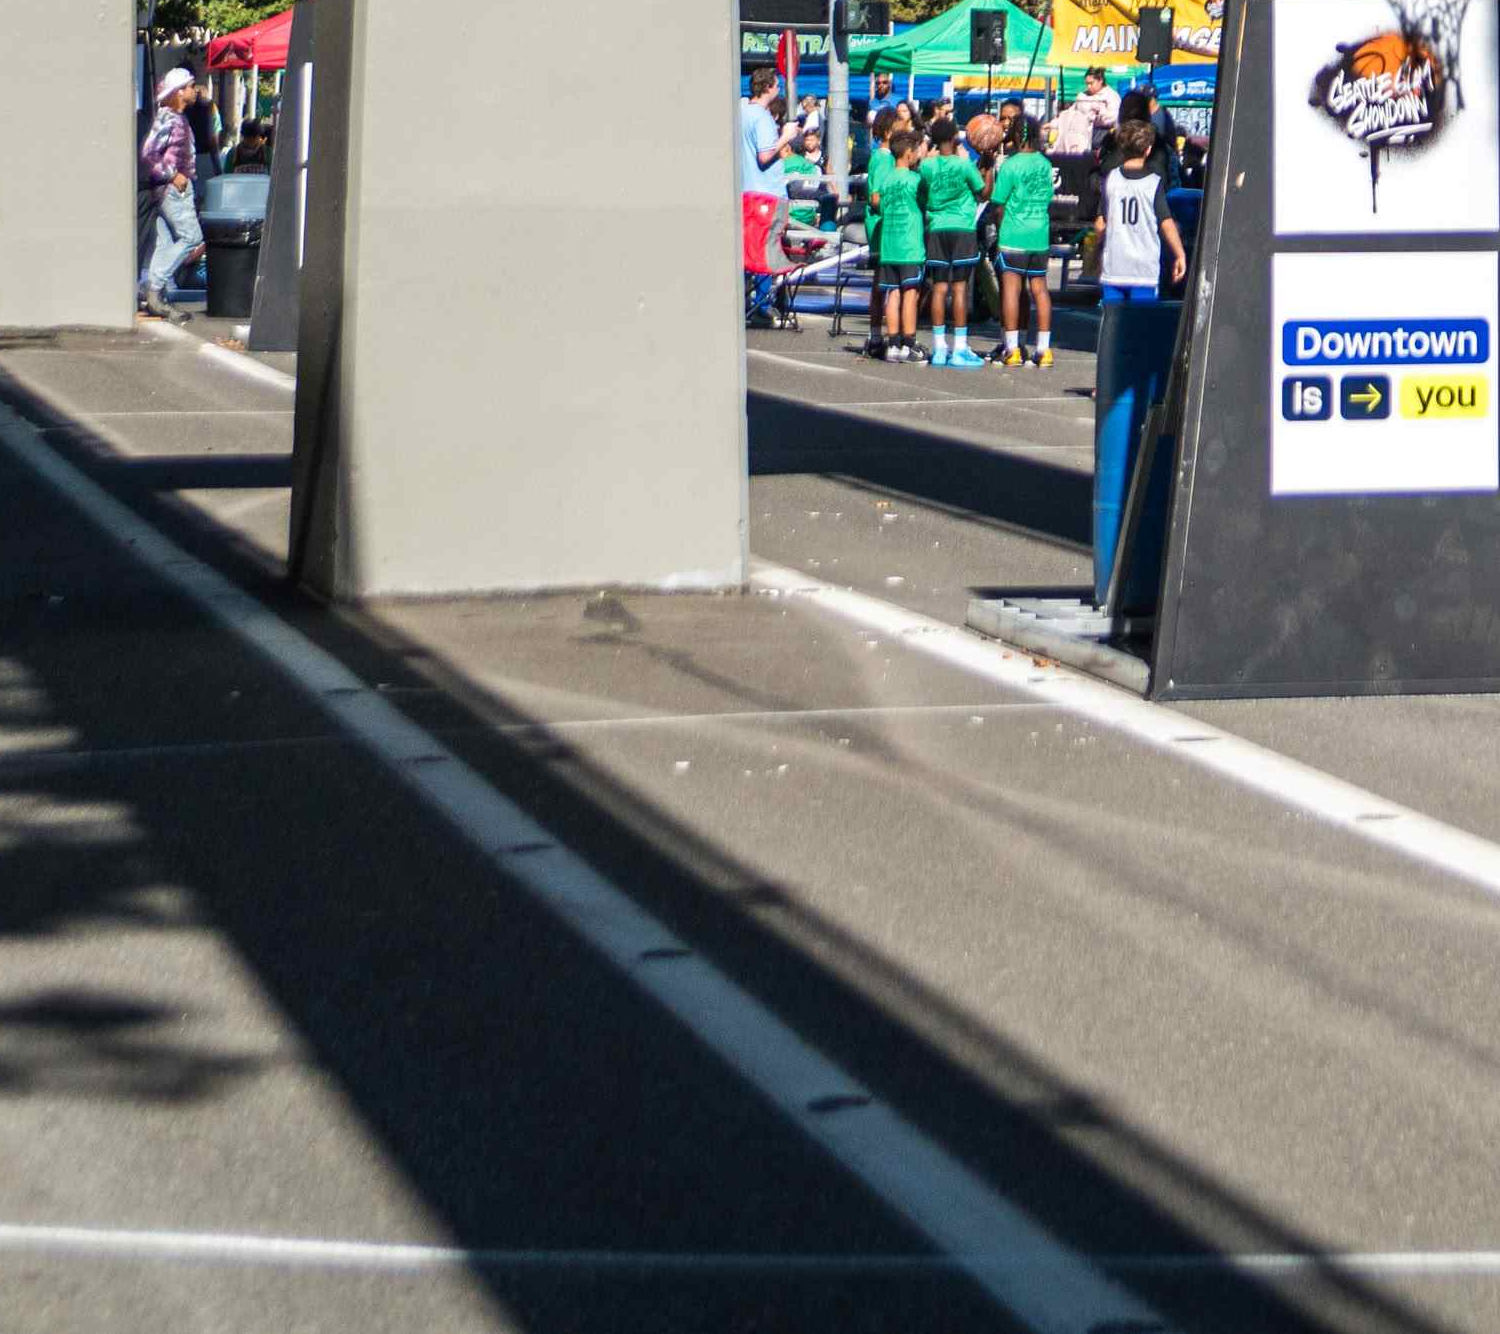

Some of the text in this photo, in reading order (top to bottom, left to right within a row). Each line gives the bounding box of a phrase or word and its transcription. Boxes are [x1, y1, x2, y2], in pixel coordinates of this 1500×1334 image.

[1119, 197, 1140, 226] 10
[1295, 322, 1479, 361] Downtown
[1292, 380, 1478, 416] is you
